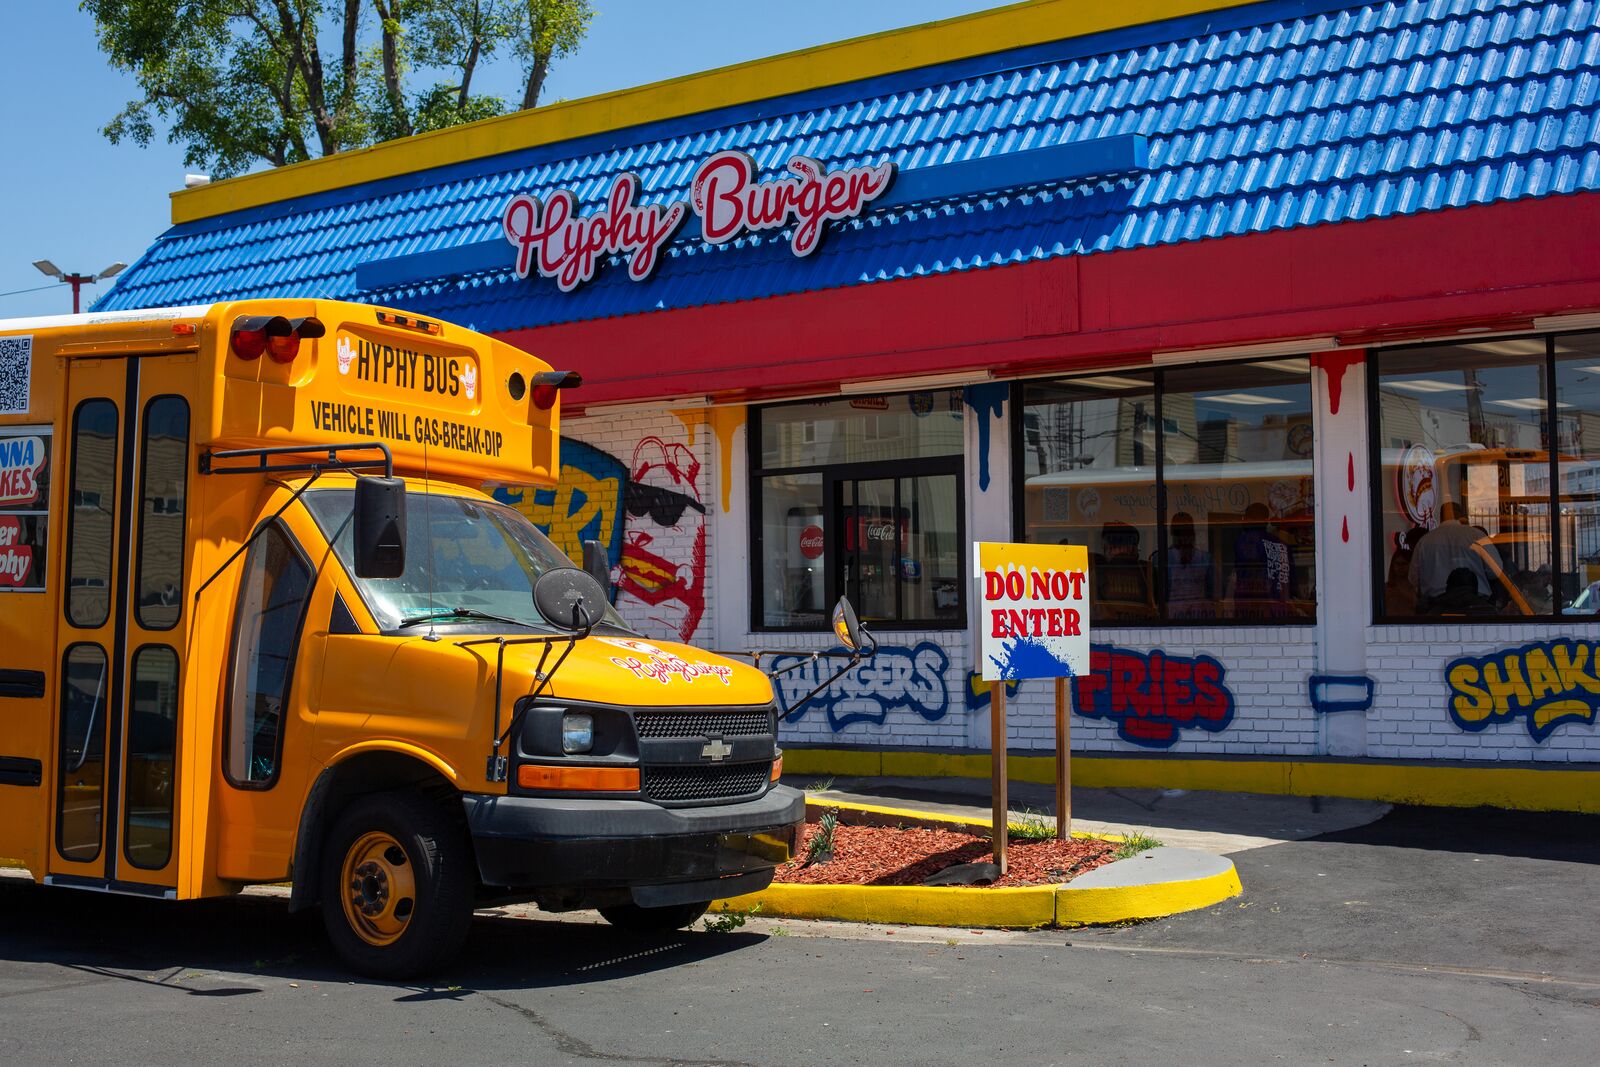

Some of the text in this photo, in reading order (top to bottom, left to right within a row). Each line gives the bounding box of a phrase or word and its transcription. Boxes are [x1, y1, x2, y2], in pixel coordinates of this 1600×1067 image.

[505, 154, 890, 289] Hyphy Burger
[357, 339, 459, 396] HYPHY BUS
[310, 400, 374, 436] VEHICLE
[378, 409, 411, 441] WILL
[0, 440, 34, 467] NNA
[0, 525, 18, 546] er
[984, 571, 1086, 601] DO NOT
[991, 608, 1081, 638] ENTER
[774, 646, 946, 718] BURGERS
[1075, 649, 1231, 723] FRIES
[1448, 642, 1600, 722] SHAK
